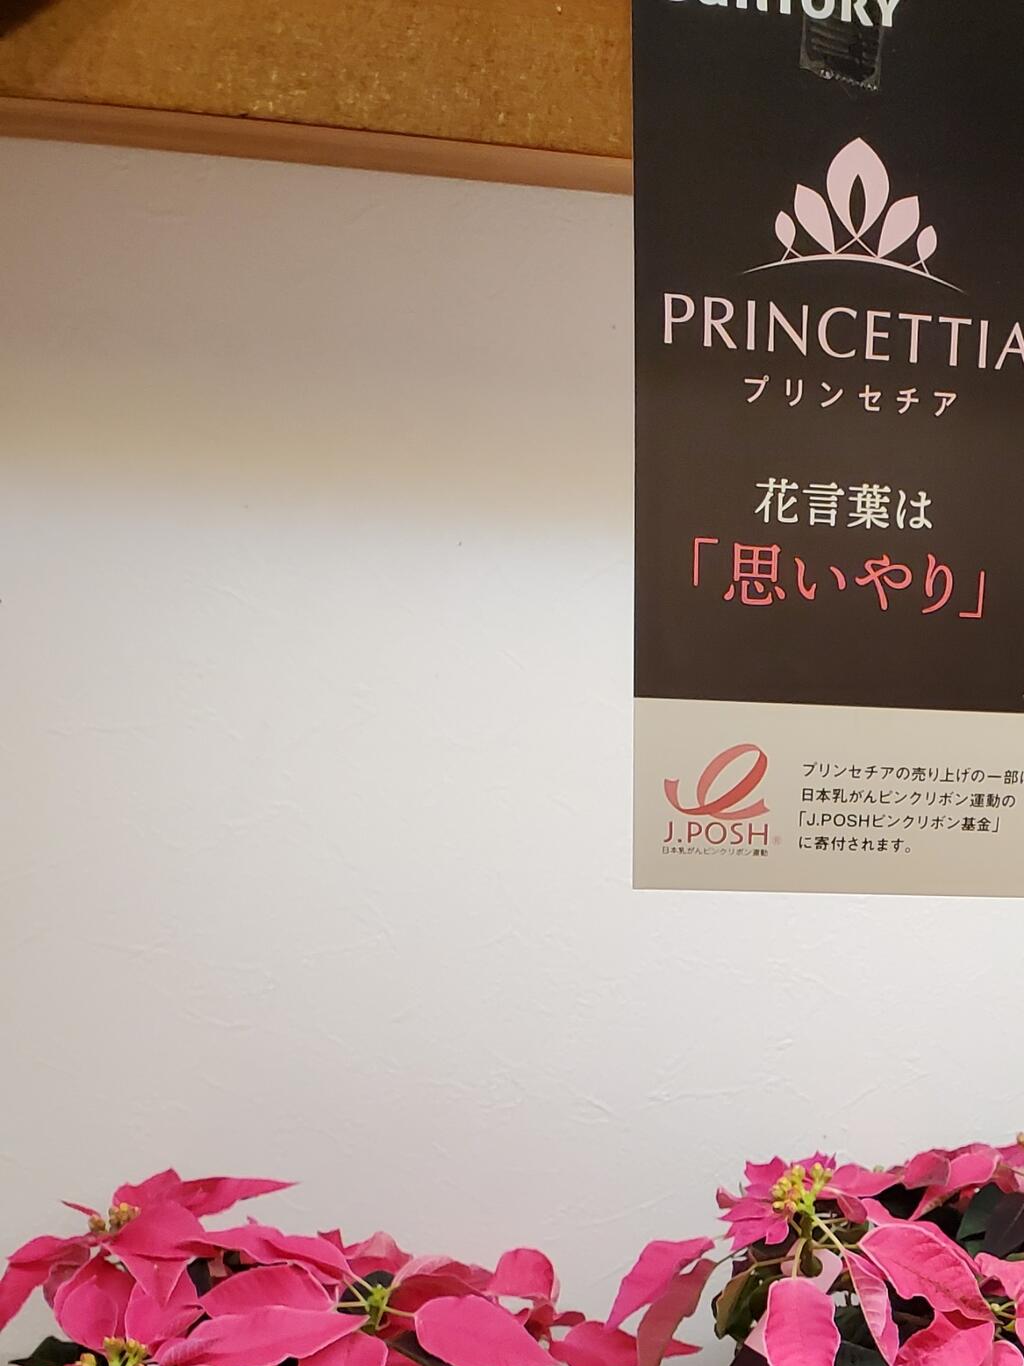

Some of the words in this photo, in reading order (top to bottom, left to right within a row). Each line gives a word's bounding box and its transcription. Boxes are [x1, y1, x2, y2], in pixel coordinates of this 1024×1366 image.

[743, 374, 957, 416] プリンセチア
[753, 477, 934, 530] 花言葉は
[692, 538, 986, 619] 「思いやり」
[802, 788, 1016, 809] 日本乳がんピンクリボン運動の
[664, 821, 768, 846] J.POSH
[798, 834, 912, 855] に寄付されます。
